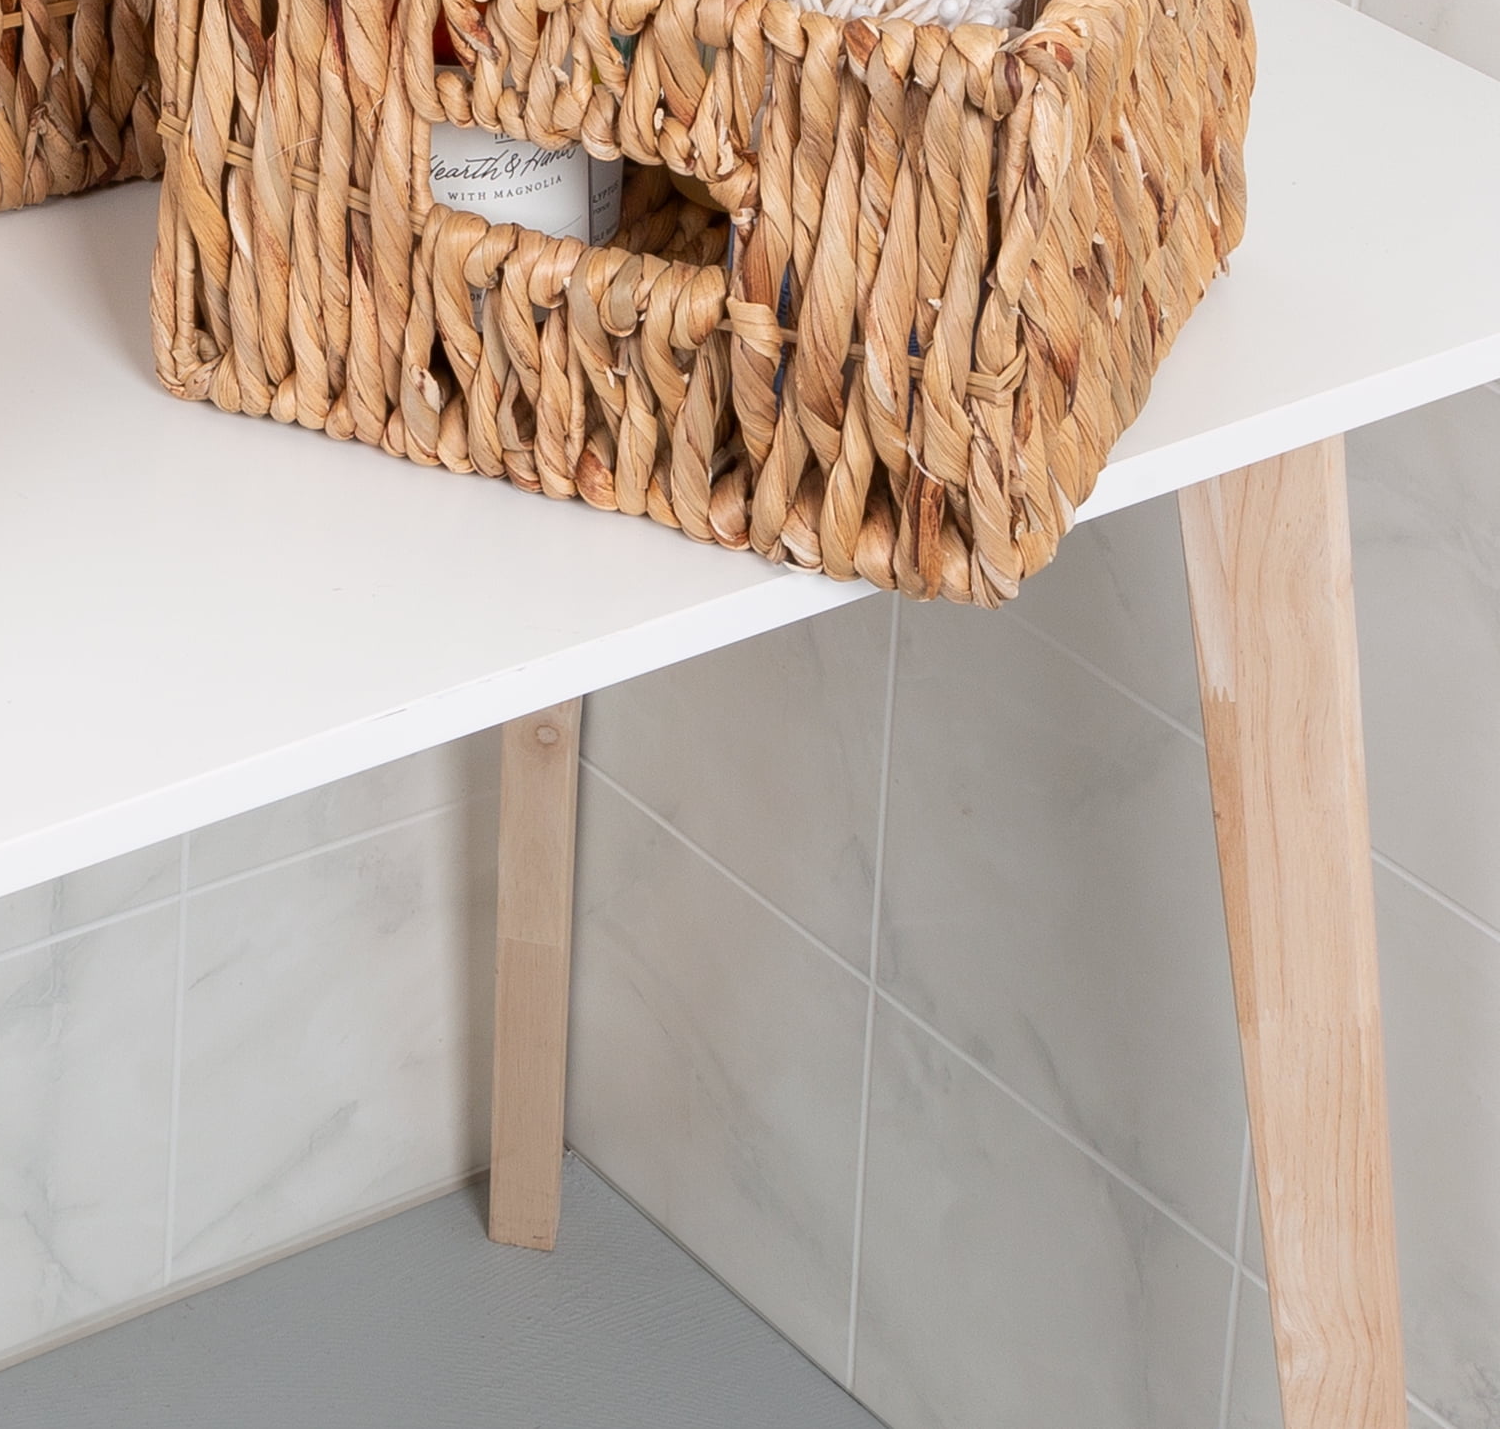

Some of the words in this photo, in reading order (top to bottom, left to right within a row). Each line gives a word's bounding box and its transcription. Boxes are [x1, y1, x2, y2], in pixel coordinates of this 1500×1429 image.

[504, 153, 520, 179] &
[447, 191, 486, 201] WITH
[493, 175, 563, 199] MAGNOLIA
